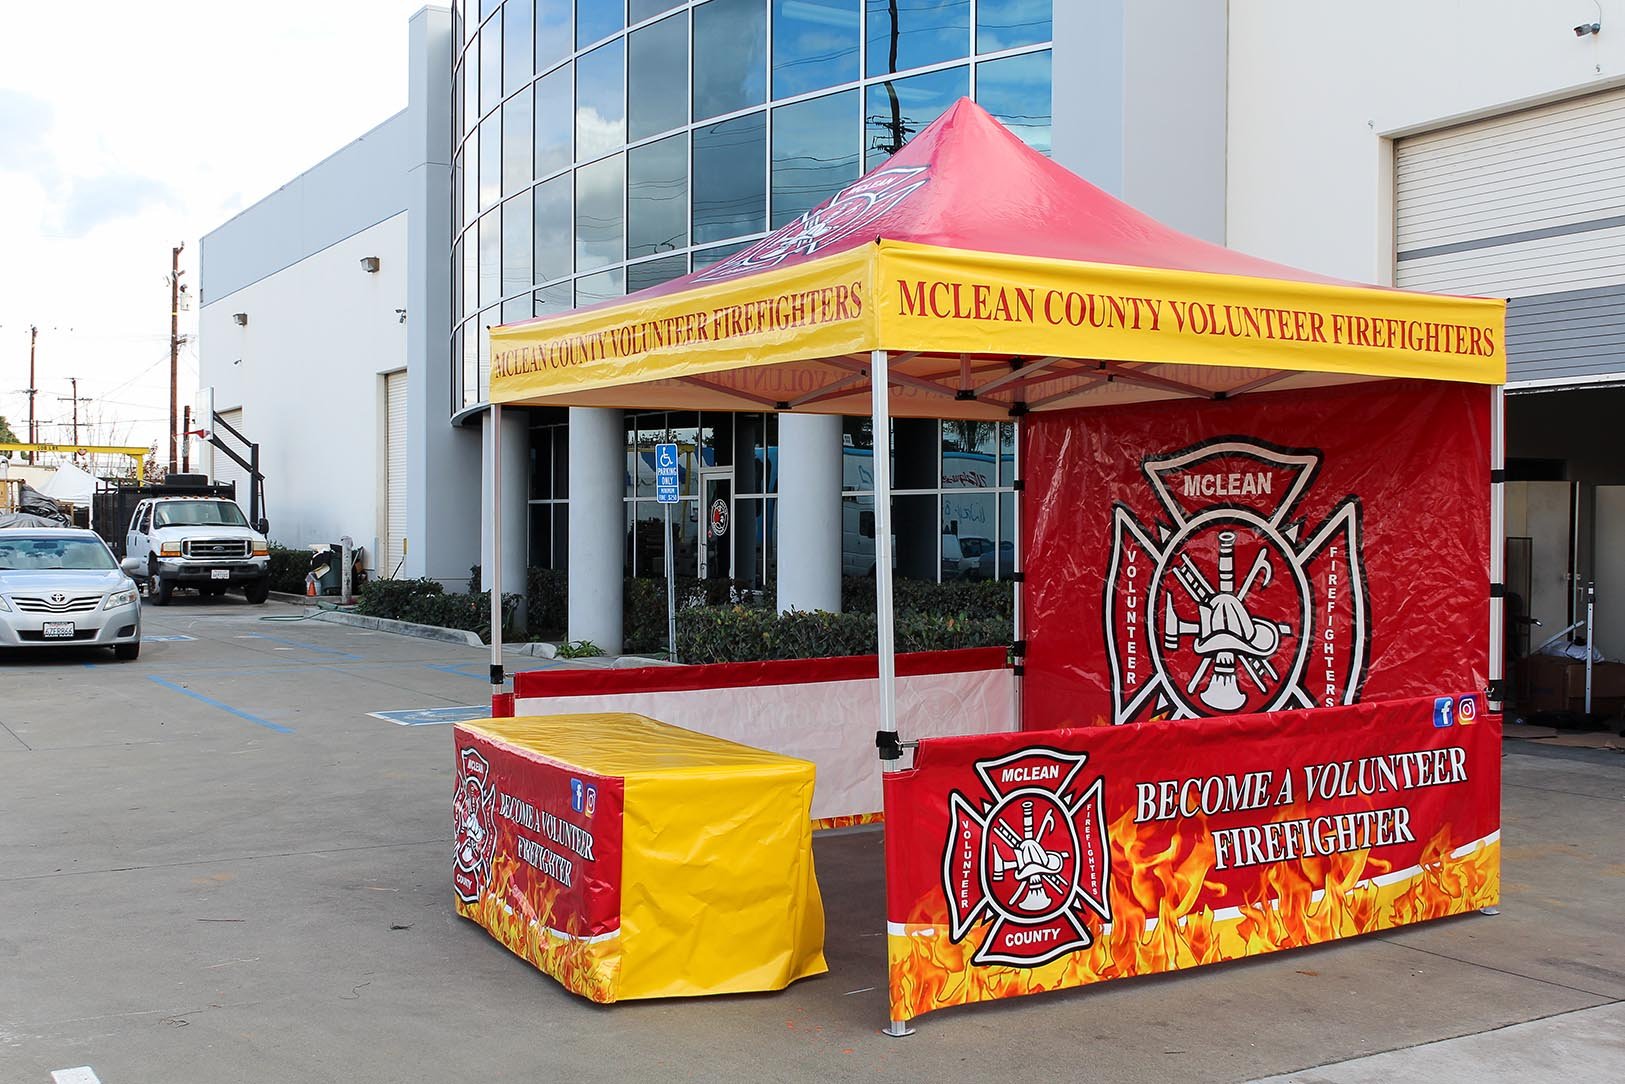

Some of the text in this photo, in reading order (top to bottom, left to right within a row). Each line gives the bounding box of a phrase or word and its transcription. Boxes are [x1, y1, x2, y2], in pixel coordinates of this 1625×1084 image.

[495, 281, 863, 379] MCLEAN COUNTY VOLUNTEER FIREFIGHTERS
[897, 279, 1495, 358] MCLEAN COUNTY VOLUNTEER FIREFIGHTERS
[661, 476, 673, 485] ONLY
[1184, 472, 1272, 496] MCLEAN
[1127, 550, 1137, 684] VOLUNTEER
[1323, 546, 1338, 707] FIREFIGHTERS
[1001, 765, 1059, 782] MCLEAN
[1134, 746, 1468, 823] BECOME A VOLUNTEER
[499, 793, 534, 830] BECOME
[534, 809, 540, 833] A
[541, 810, 595, 861] VOLUNTEER
[517, 835, 572, 887] FIREFIGHTER
[1085, 804, 1098, 895] FIREFIGHTERS
[1211, 807, 1415, 870] FIREFIGHTER
[961, 820, 972, 908] VOLUNTEER
[1005, 928, 1061, 947] COUNTY
